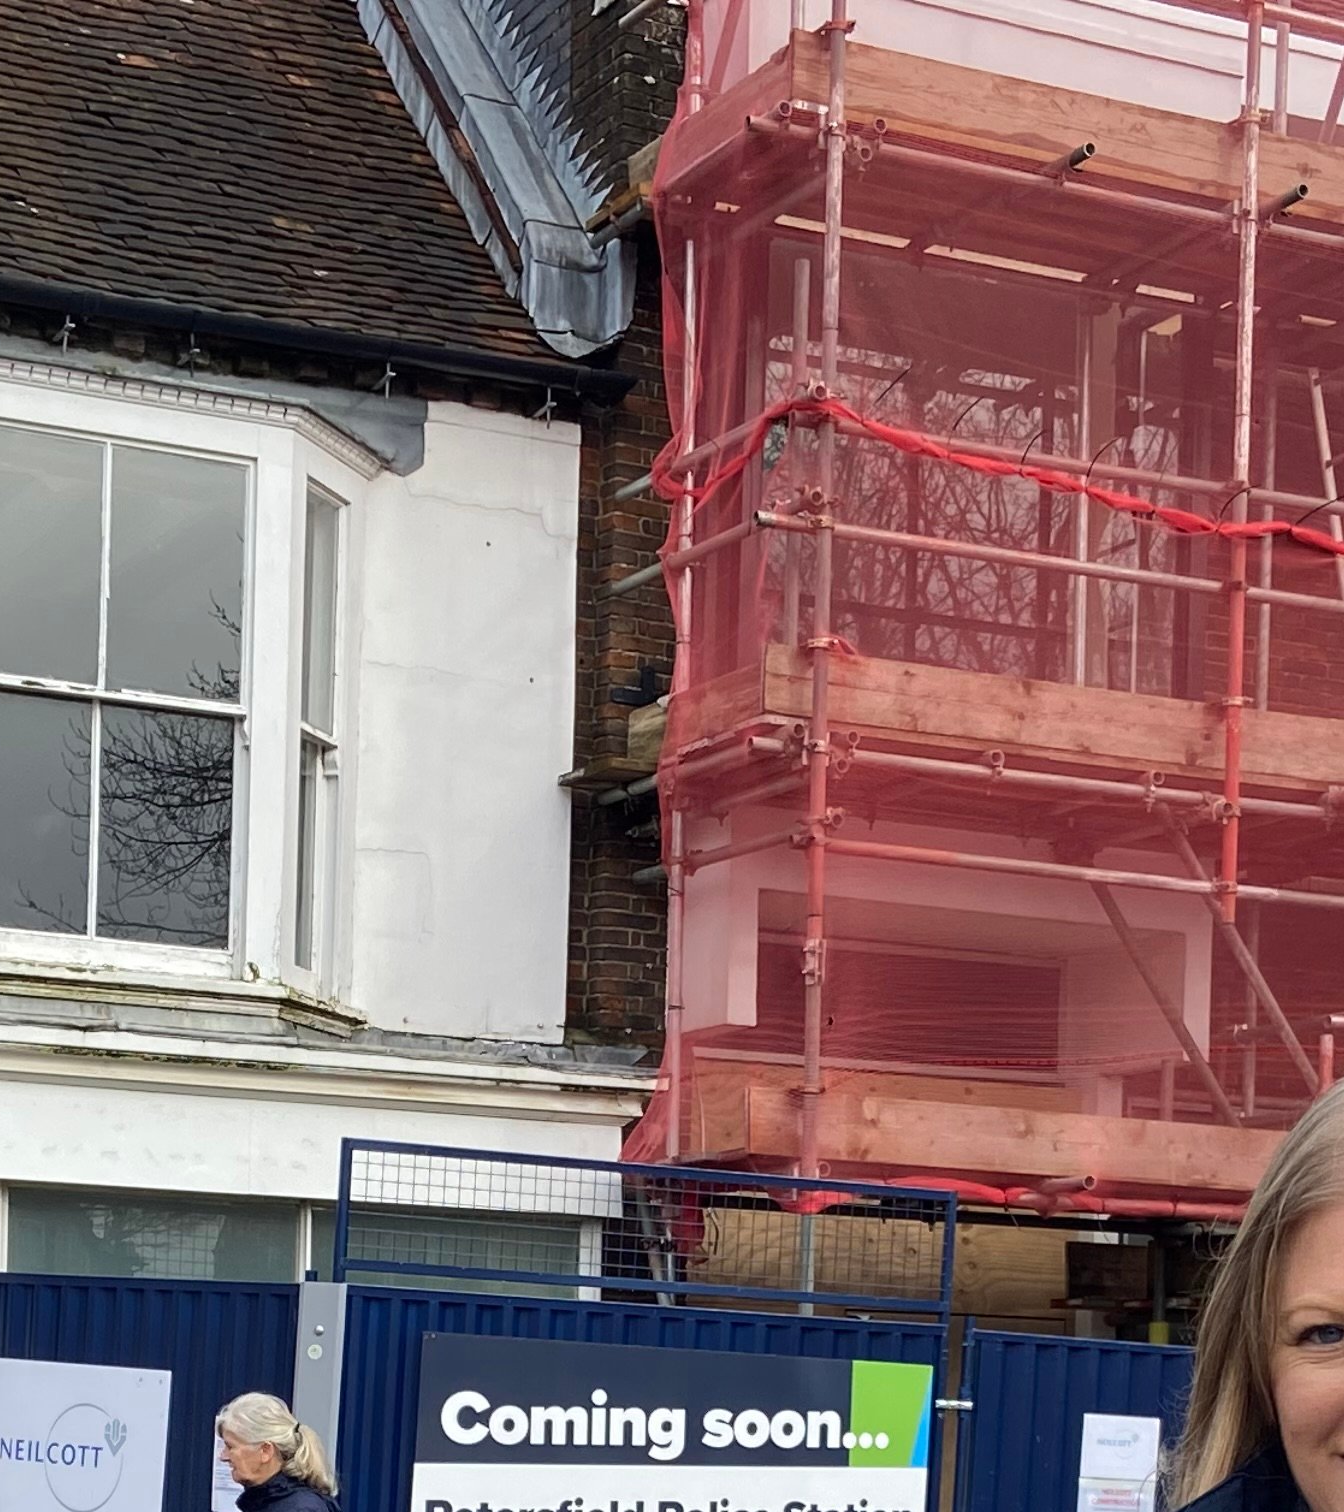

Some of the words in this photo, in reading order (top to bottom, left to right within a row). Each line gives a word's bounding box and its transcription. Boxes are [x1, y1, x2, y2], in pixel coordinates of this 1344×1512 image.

[441, 1388, 686, 1461] Coming
[702, 1408, 890, 1450] soon...
[0, 1437, 104, 1469] NEILCOTT
